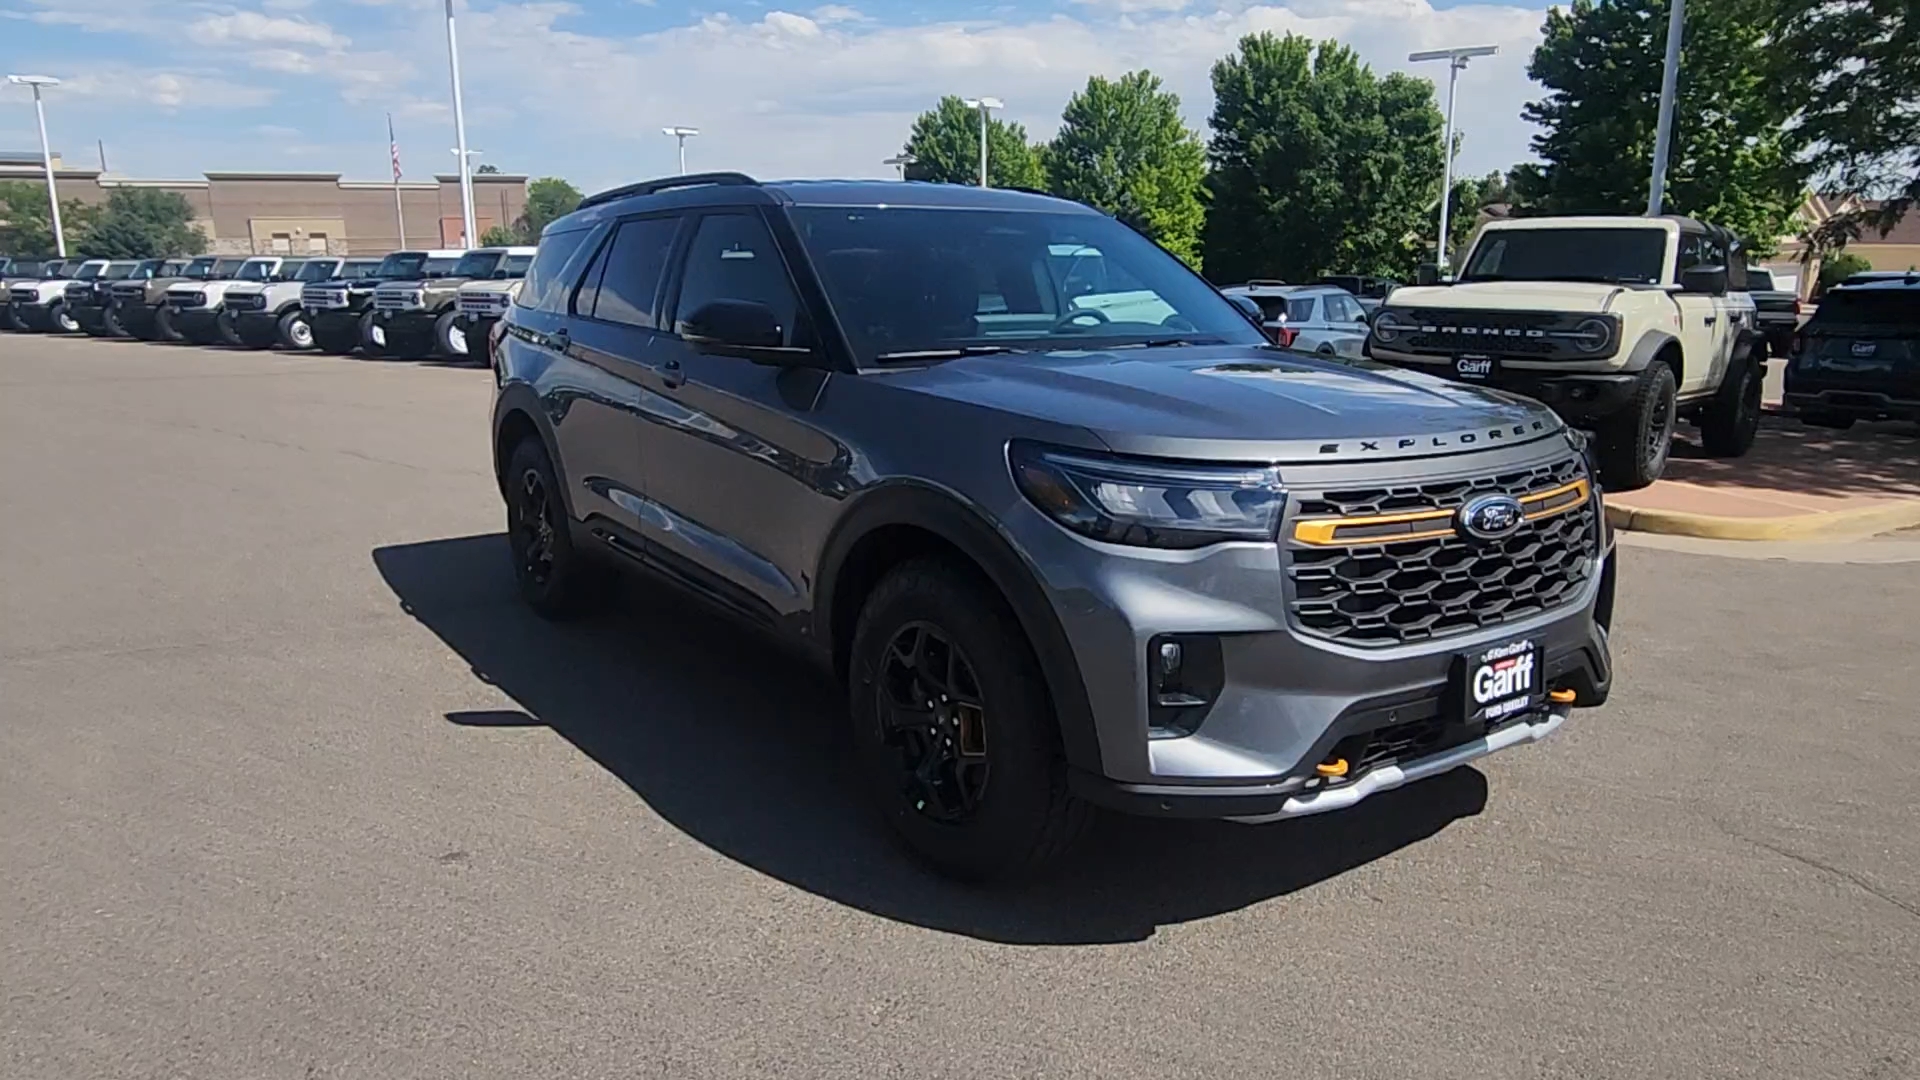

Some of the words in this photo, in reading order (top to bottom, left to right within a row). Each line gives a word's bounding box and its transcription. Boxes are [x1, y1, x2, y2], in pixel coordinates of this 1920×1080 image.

[1421, 325, 1544, 337] BRONCO
[1456, 359, 1492, 374] Garff
[1319, 420, 1544, 454] EXPLORER
[1482, 505, 1515, 530] Ford
[1473, 652, 1534, 704] Garff
